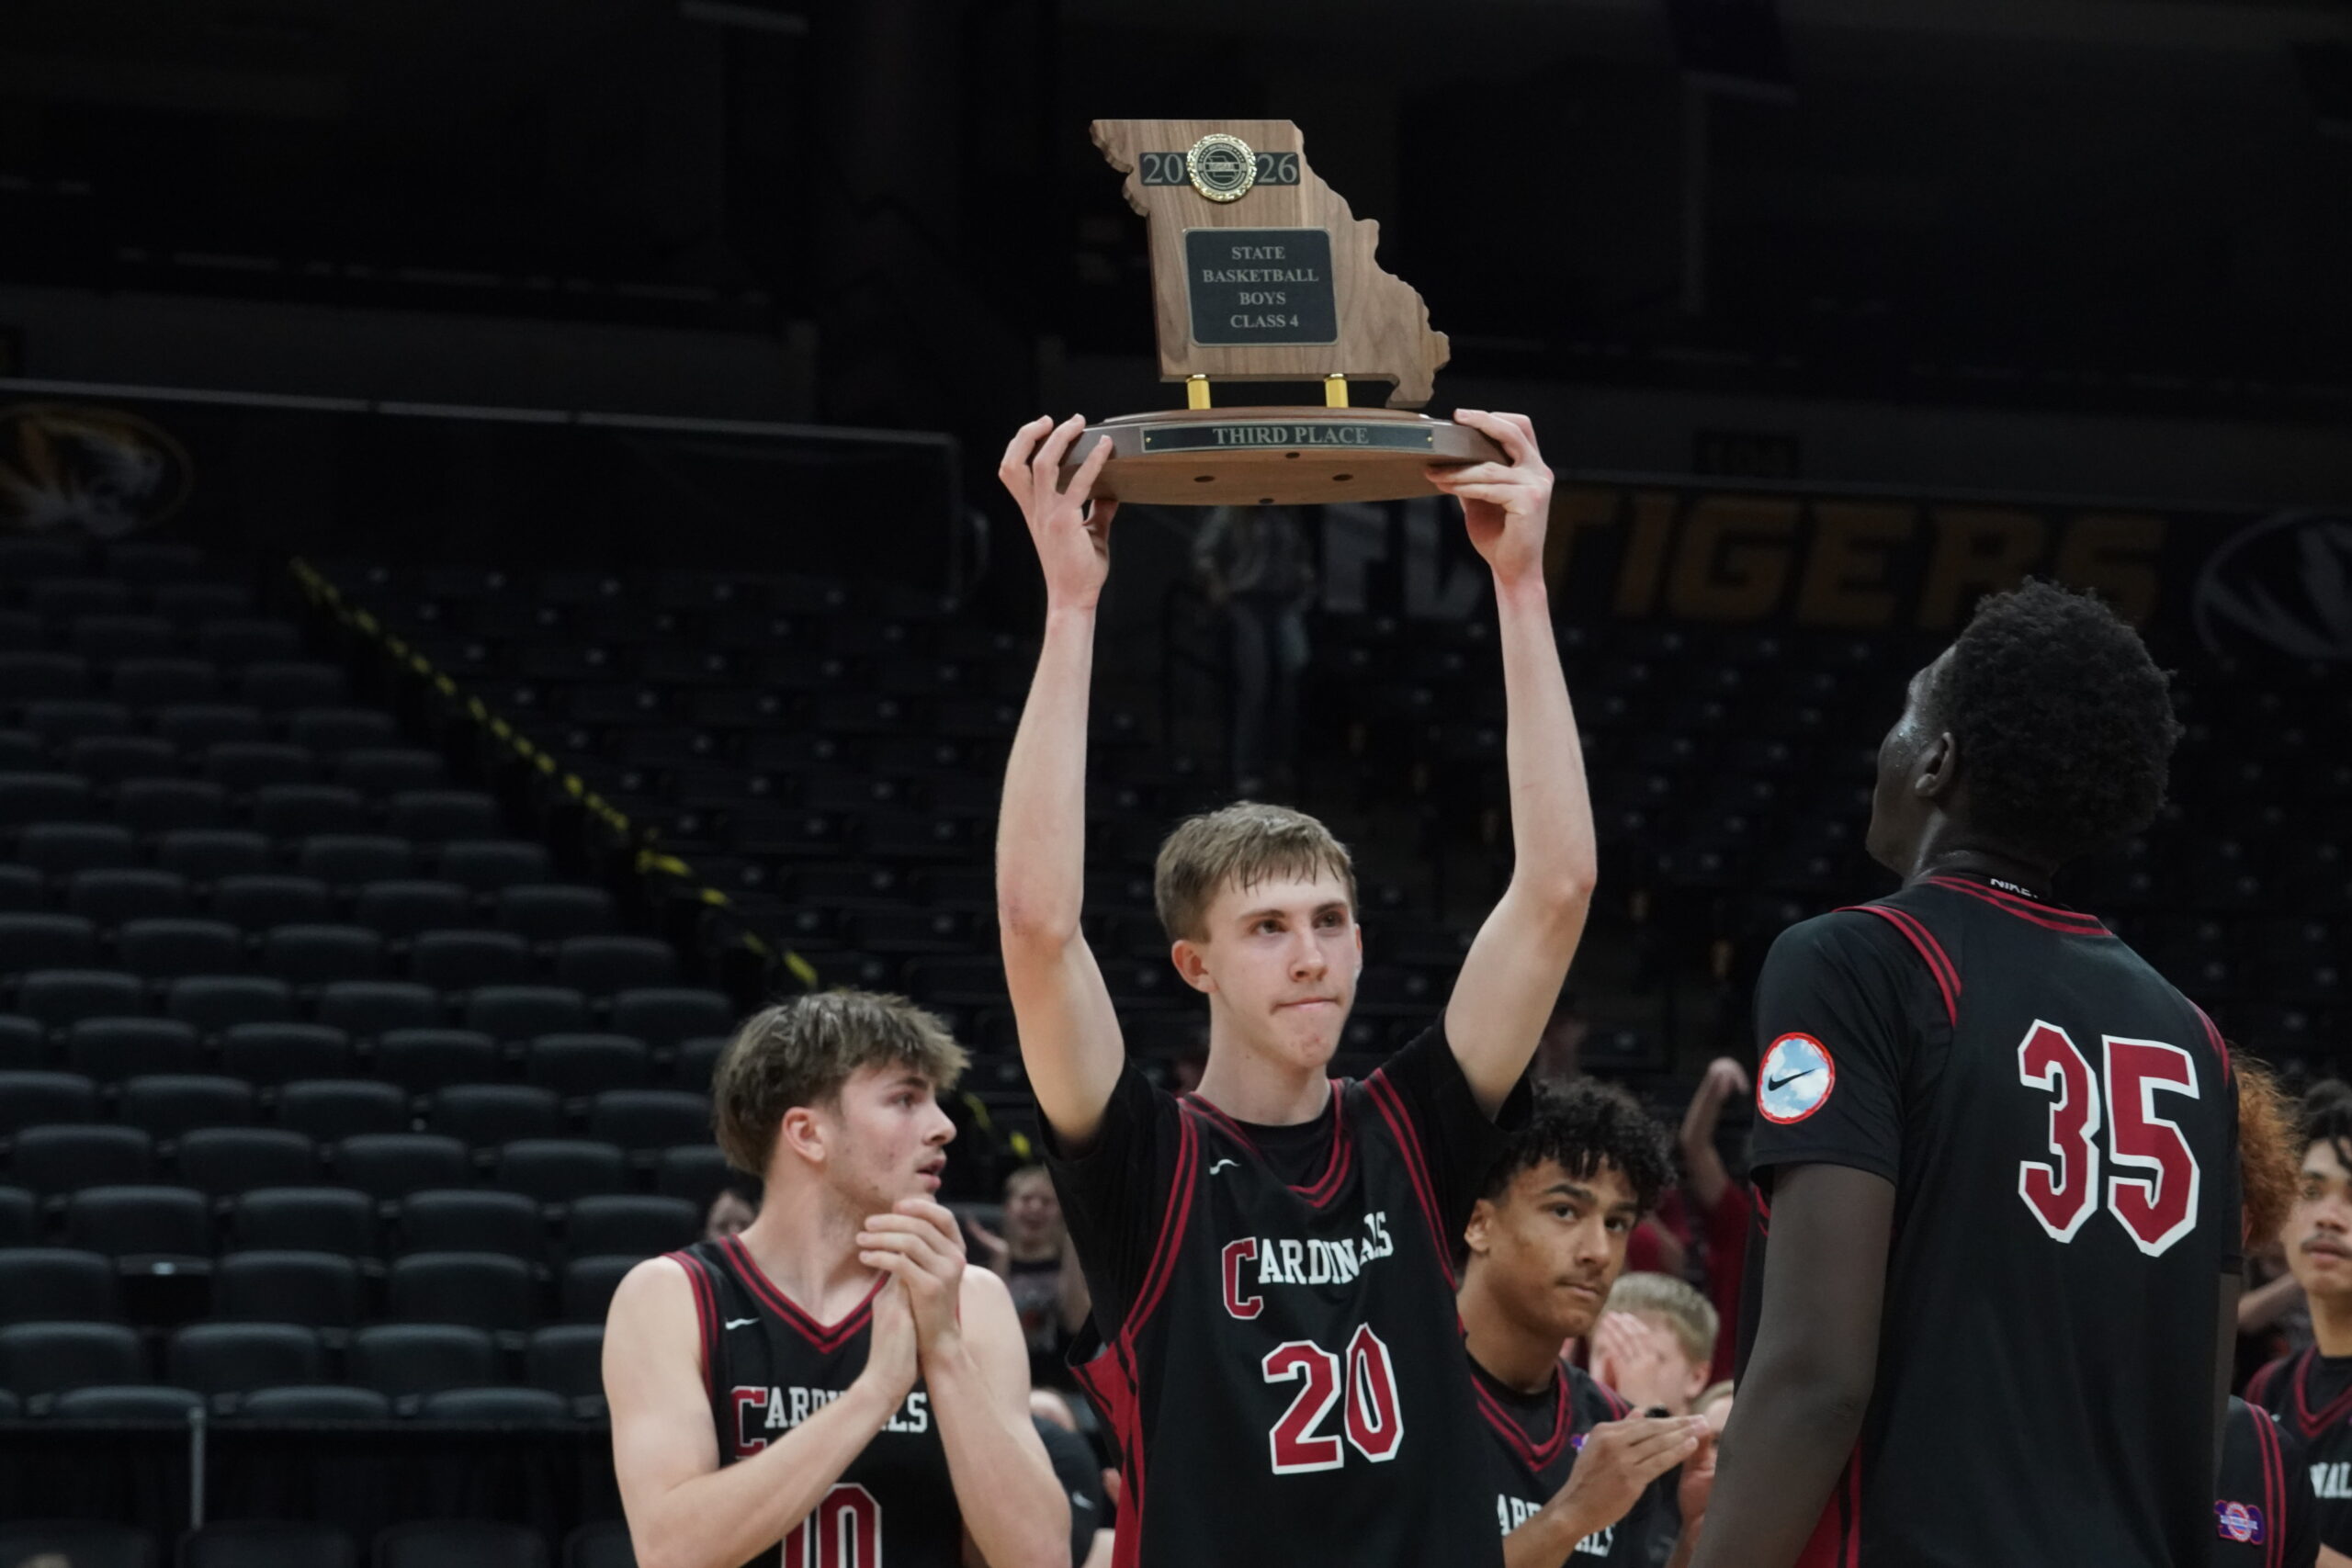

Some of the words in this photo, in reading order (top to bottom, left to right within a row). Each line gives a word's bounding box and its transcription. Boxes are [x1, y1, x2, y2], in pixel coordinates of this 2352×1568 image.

[1144, 153, 1183, 184] 20
[1258, 153, 1297, 183] 26
[1231, 245, 1285, 260] STATE
[1203, 268, 1319, 283] BASKETBALL
[1239, 292, 1286, 306] BOYS
[1230, 314, 1285, 328] CLASS
[1290, 314, 1299, 328] 4
[1213, 428, 1287, 445] THIRD
[1294, 427, 1369, 445] PLACE
[1547, 486, 2170, 634] TIGERS
[2018, 1019, 2200, 1258] 35
[1222, 1211, 1394, 1320] CARDINALS
[1261, 1322, 1404, 1474] 20
